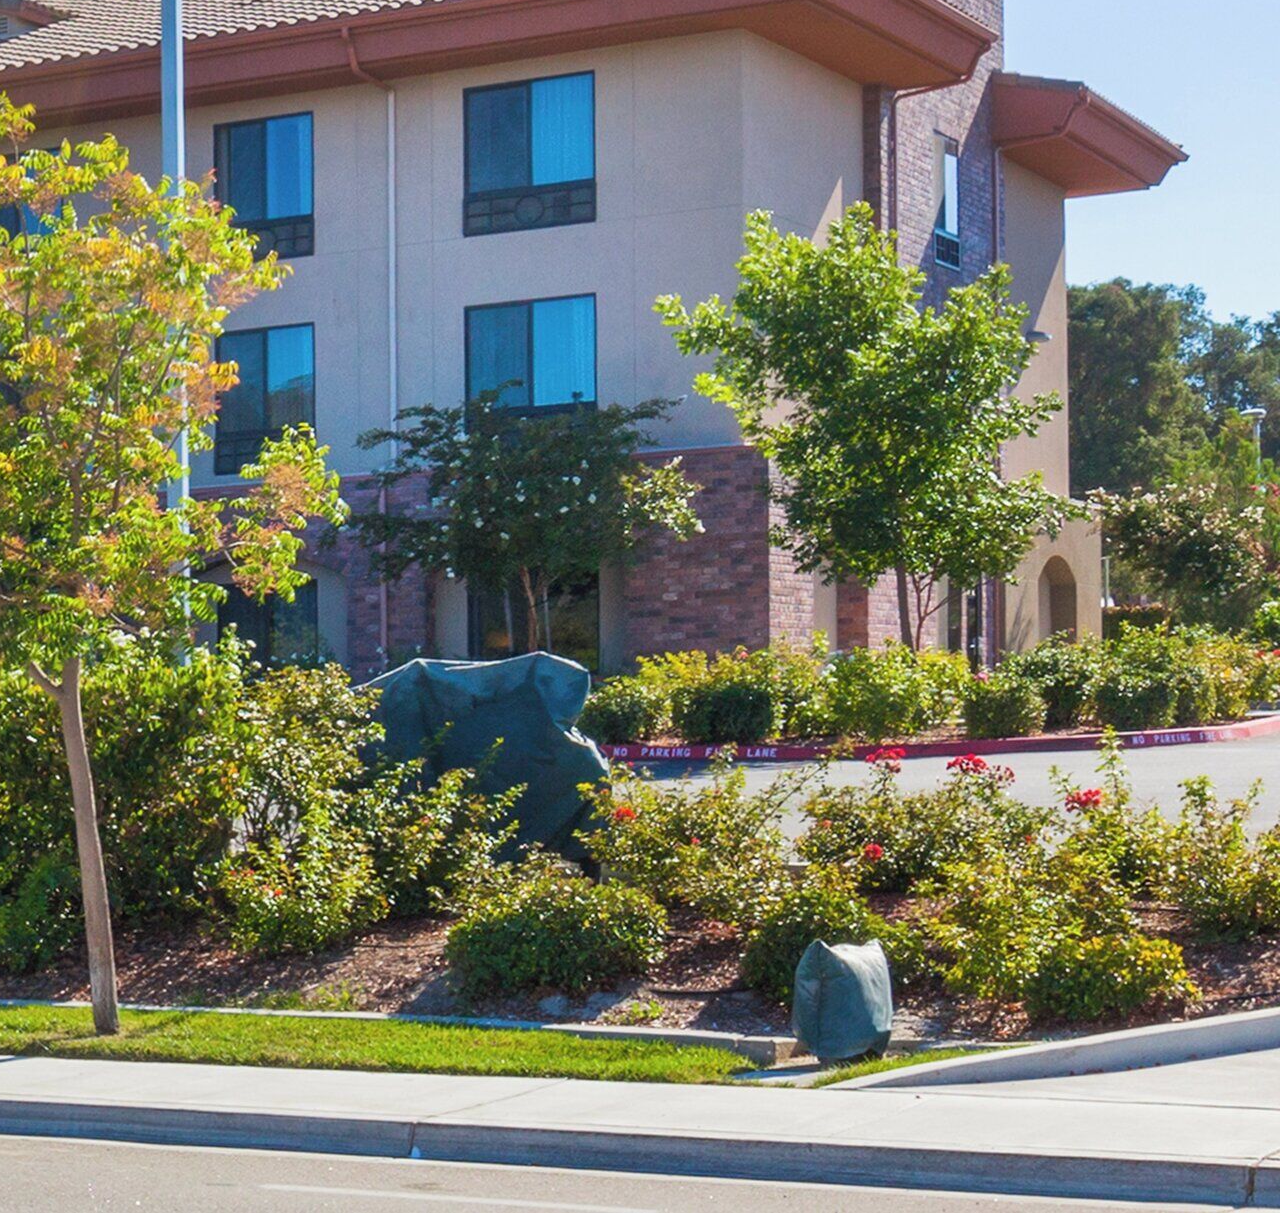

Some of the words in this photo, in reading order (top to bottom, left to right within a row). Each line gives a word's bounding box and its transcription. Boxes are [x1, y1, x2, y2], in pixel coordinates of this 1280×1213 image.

[613, 747, 628, 757] NO
[641, 748, 691, 758] PARKING
[747, 748, 778, 758] LANE
